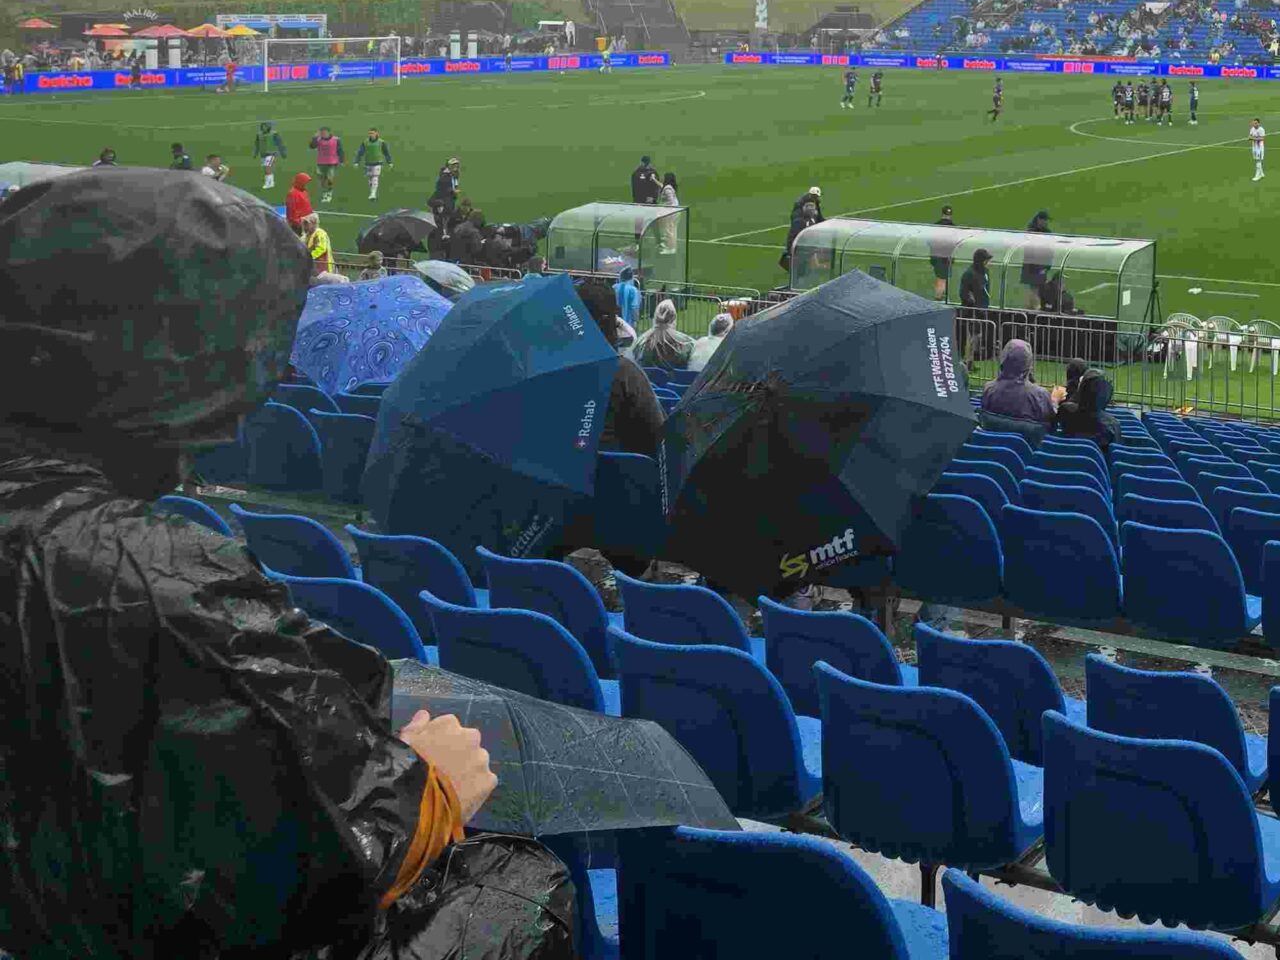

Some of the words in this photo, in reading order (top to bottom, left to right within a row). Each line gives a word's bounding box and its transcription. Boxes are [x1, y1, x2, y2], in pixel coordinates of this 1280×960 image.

[123, 8, 158, 21] MALIBU
[563, 304, 583, 330] Pilates
[927, 328, 942, 375] Waitakere
[934, 376, 947, 397] MTF
[948, 380, 958, 392] 09
[579, 400, 596, 436] Rehab
[809, 528, 854, 564] mtf
